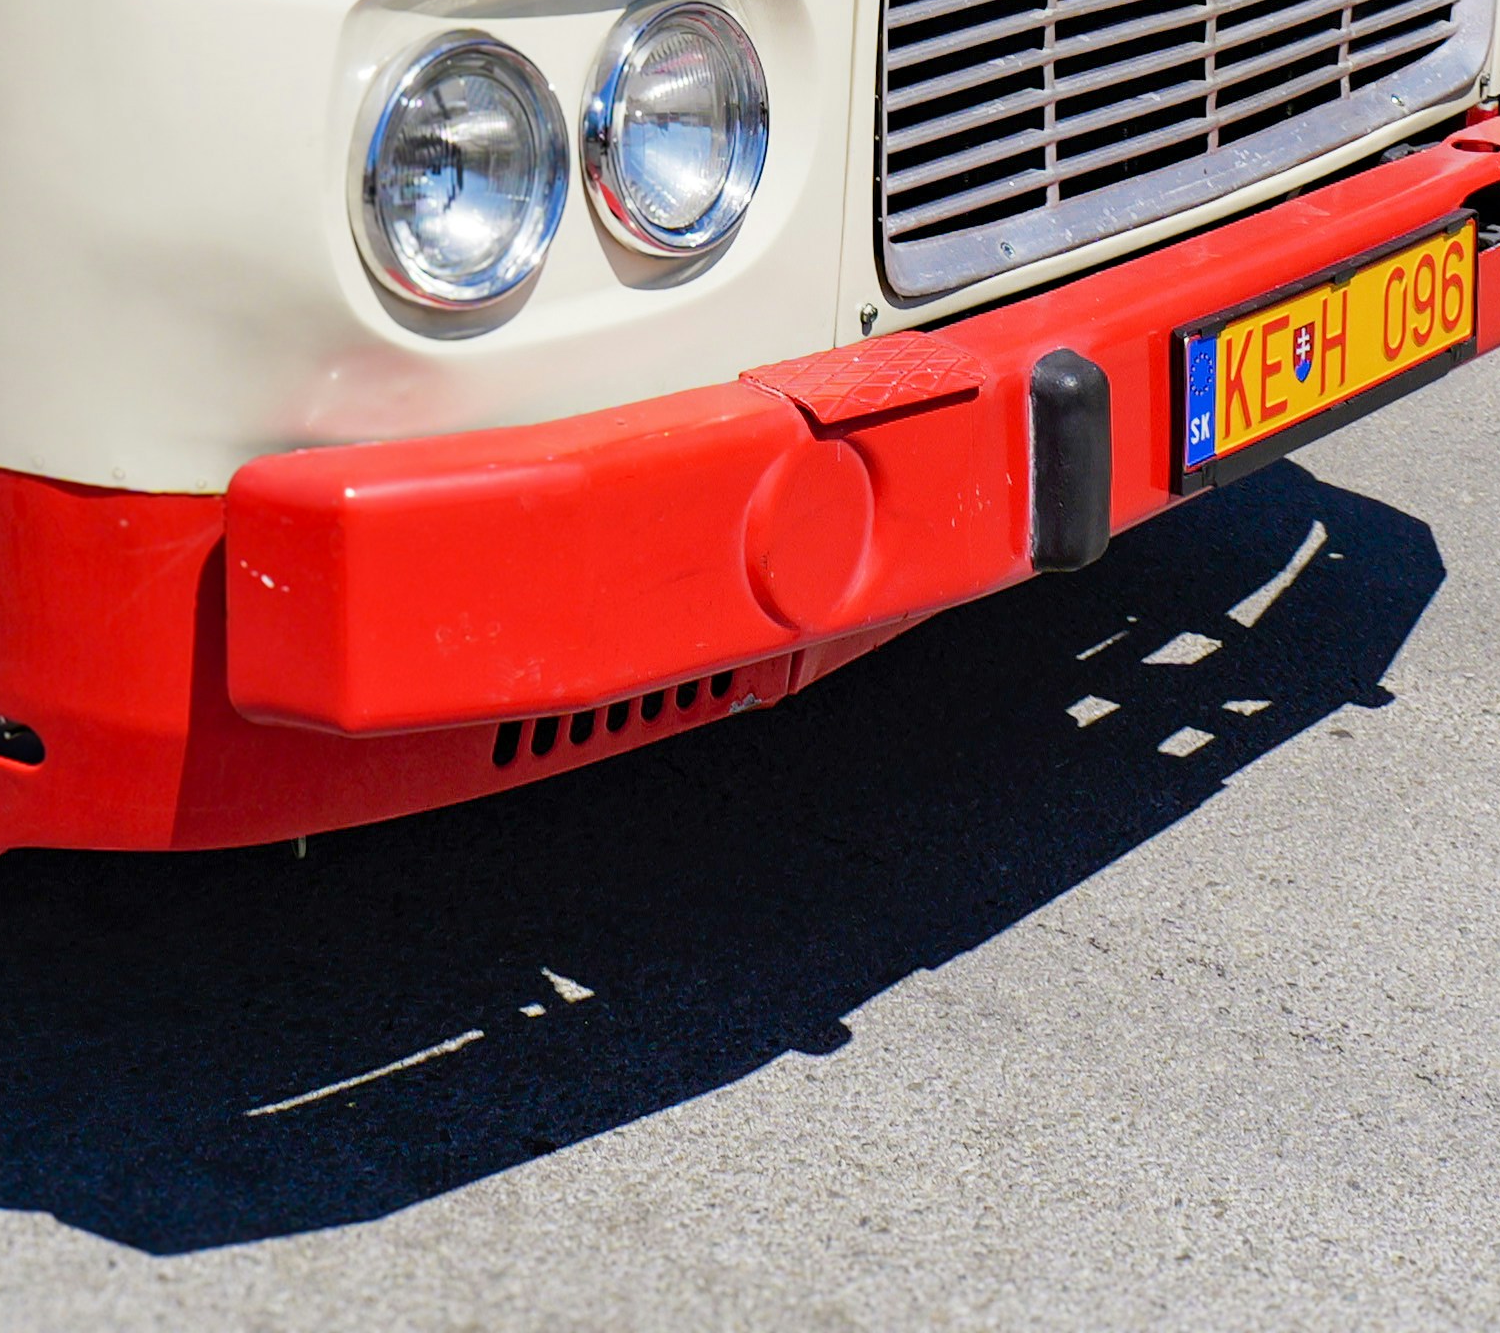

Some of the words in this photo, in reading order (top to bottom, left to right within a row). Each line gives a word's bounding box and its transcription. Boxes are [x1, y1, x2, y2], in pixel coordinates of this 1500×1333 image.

[1221, 313, 1290, 440] KE
[1319, 289, 1349, 397] H
[1382, 239, 1465, 362] 096
[1189, 412, 1211, 446] SK
